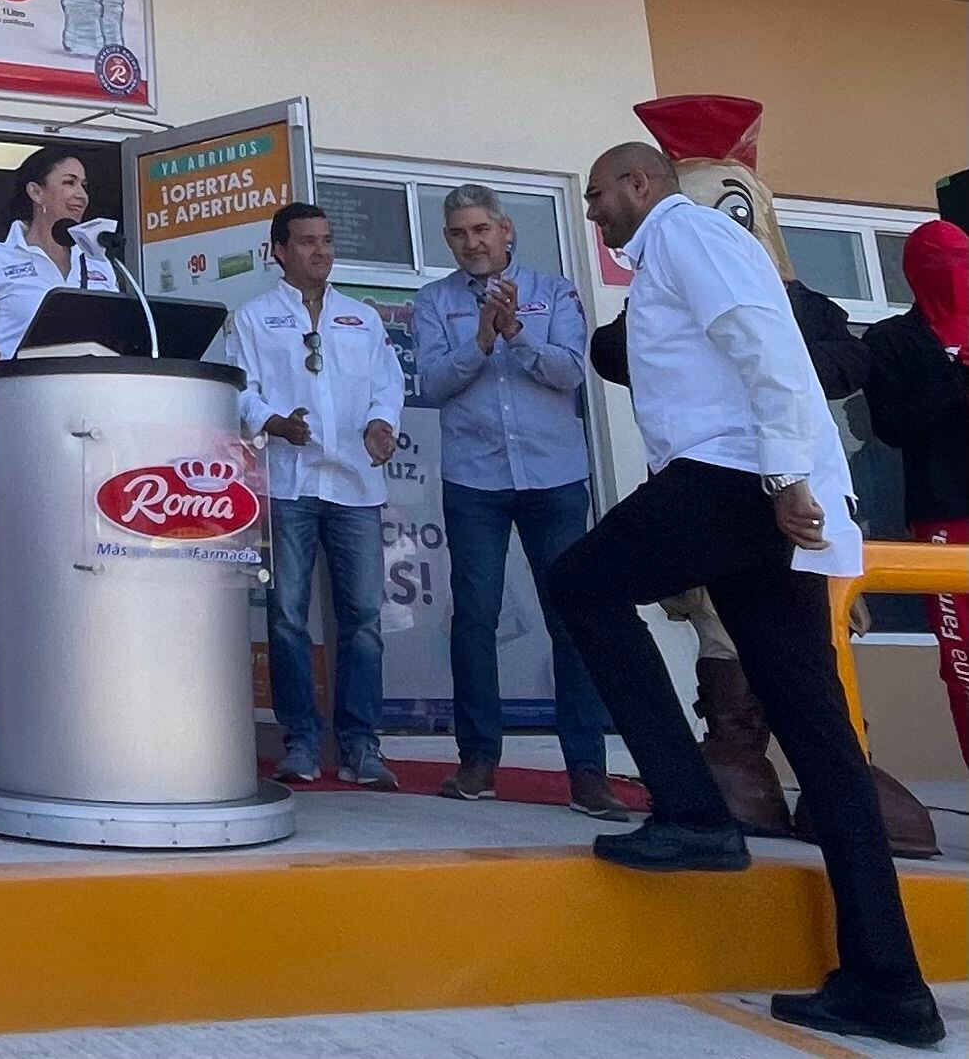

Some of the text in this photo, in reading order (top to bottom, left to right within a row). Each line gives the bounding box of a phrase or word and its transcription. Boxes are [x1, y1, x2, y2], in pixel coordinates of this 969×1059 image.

[160, 141, 259, 177] YA ABRIMOS
[160, 168, 254, 206] ¡OFERTAS
[146, 209, 170, 231] DE
[121, 473, 235, 525] Roma
[96, 543, 128, 557] Más
[382, 560, 433, 605] S!
